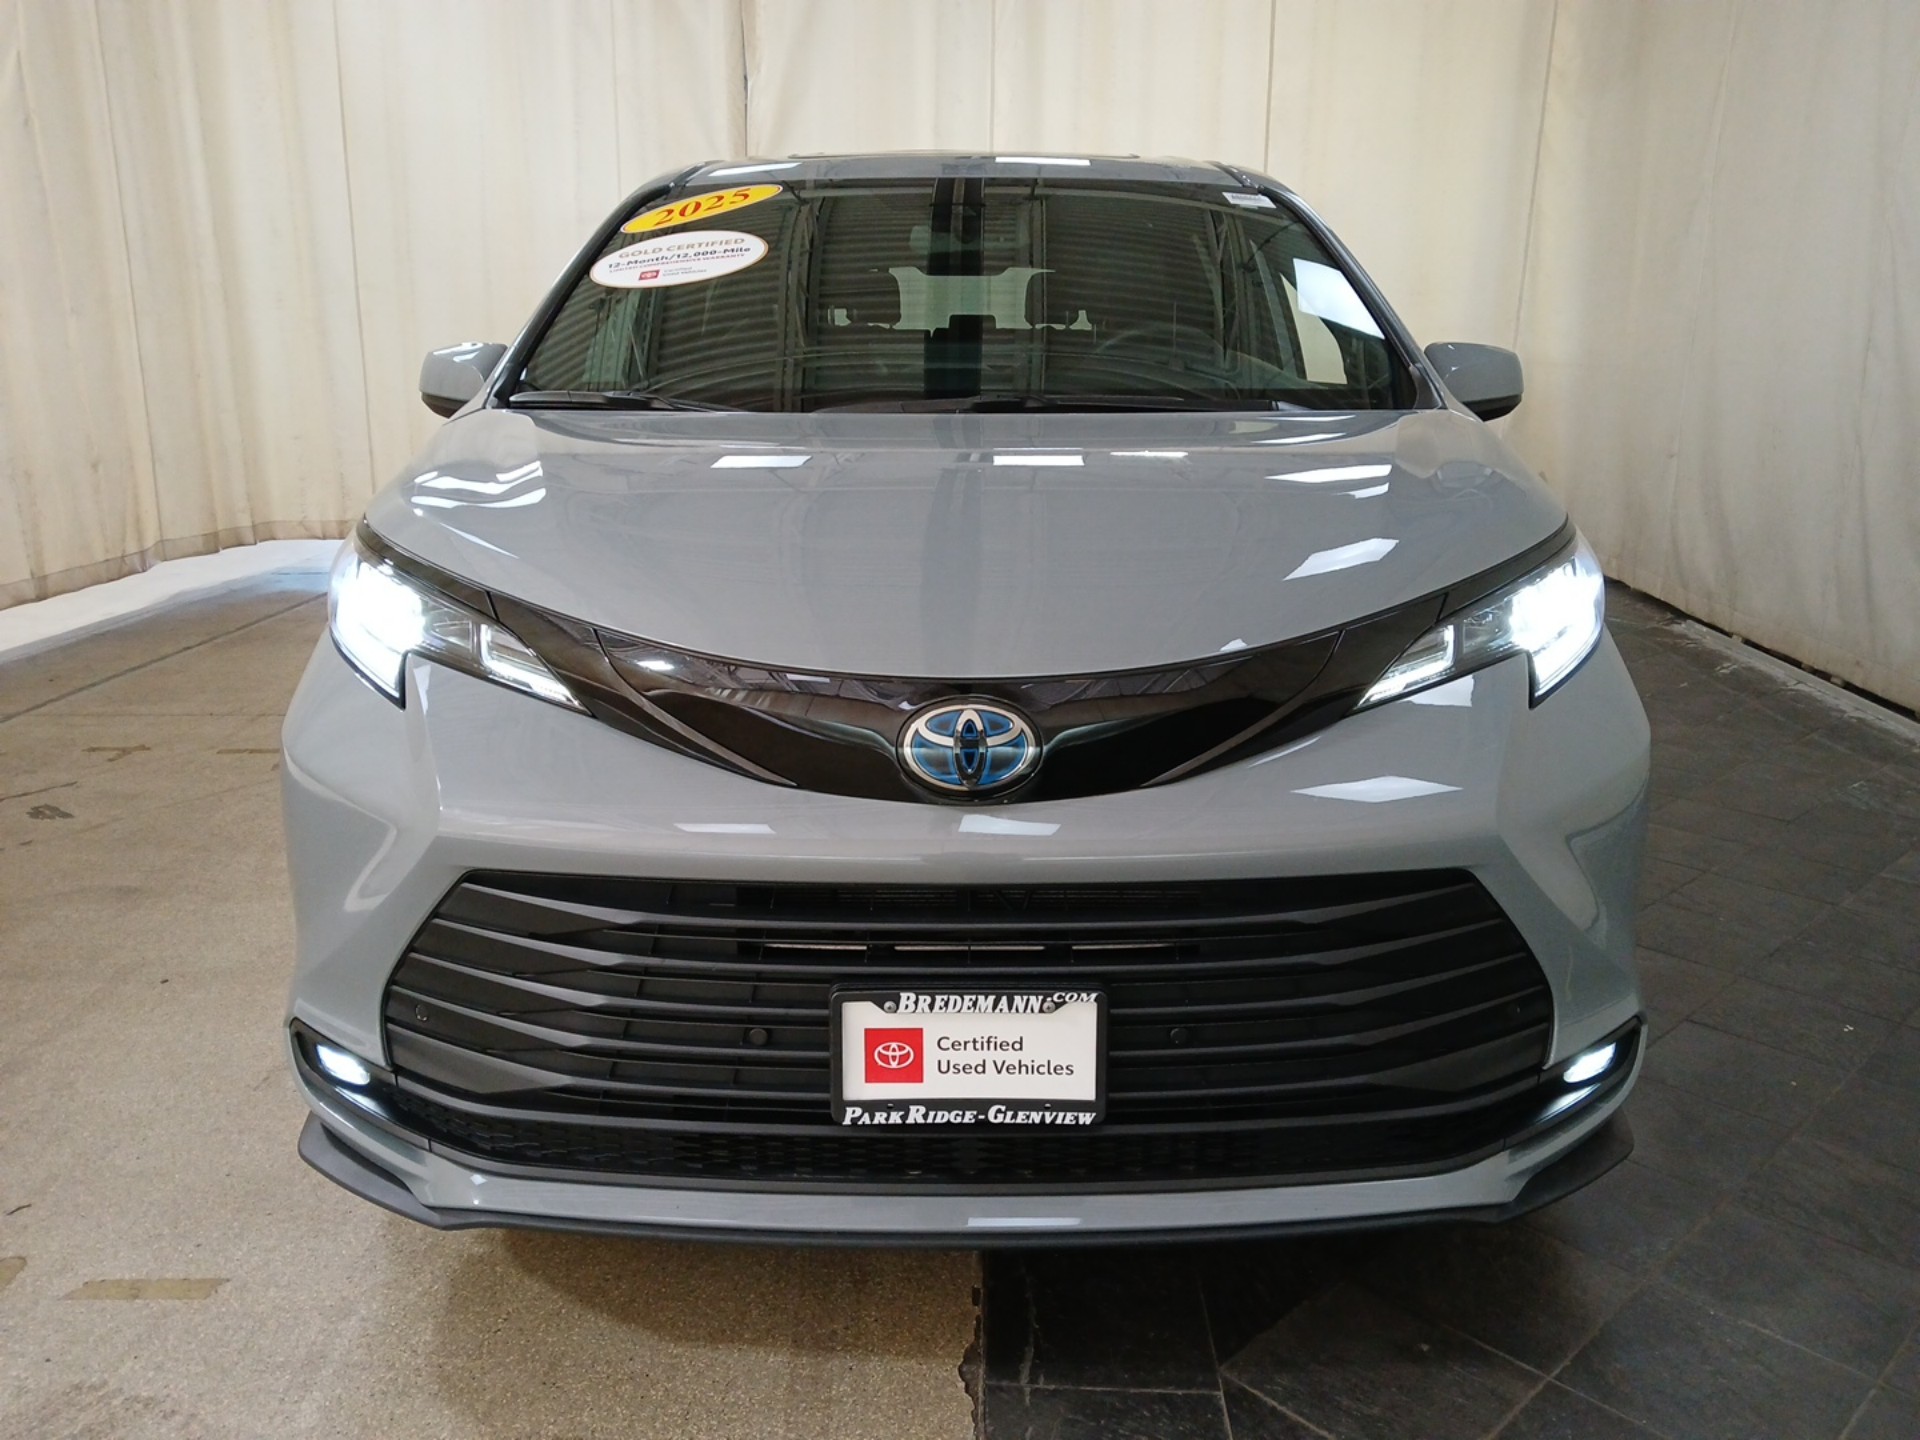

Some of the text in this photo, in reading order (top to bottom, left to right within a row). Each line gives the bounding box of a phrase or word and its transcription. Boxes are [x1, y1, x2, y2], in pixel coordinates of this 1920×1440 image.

[653, 187, 752, 226] 2025
[619, 238, 746, 259] GOLD CERTIFIED
[936, 1036, 1024, 1052] Certified
[936, 1059, 1075, 1076] Used Vehicles
